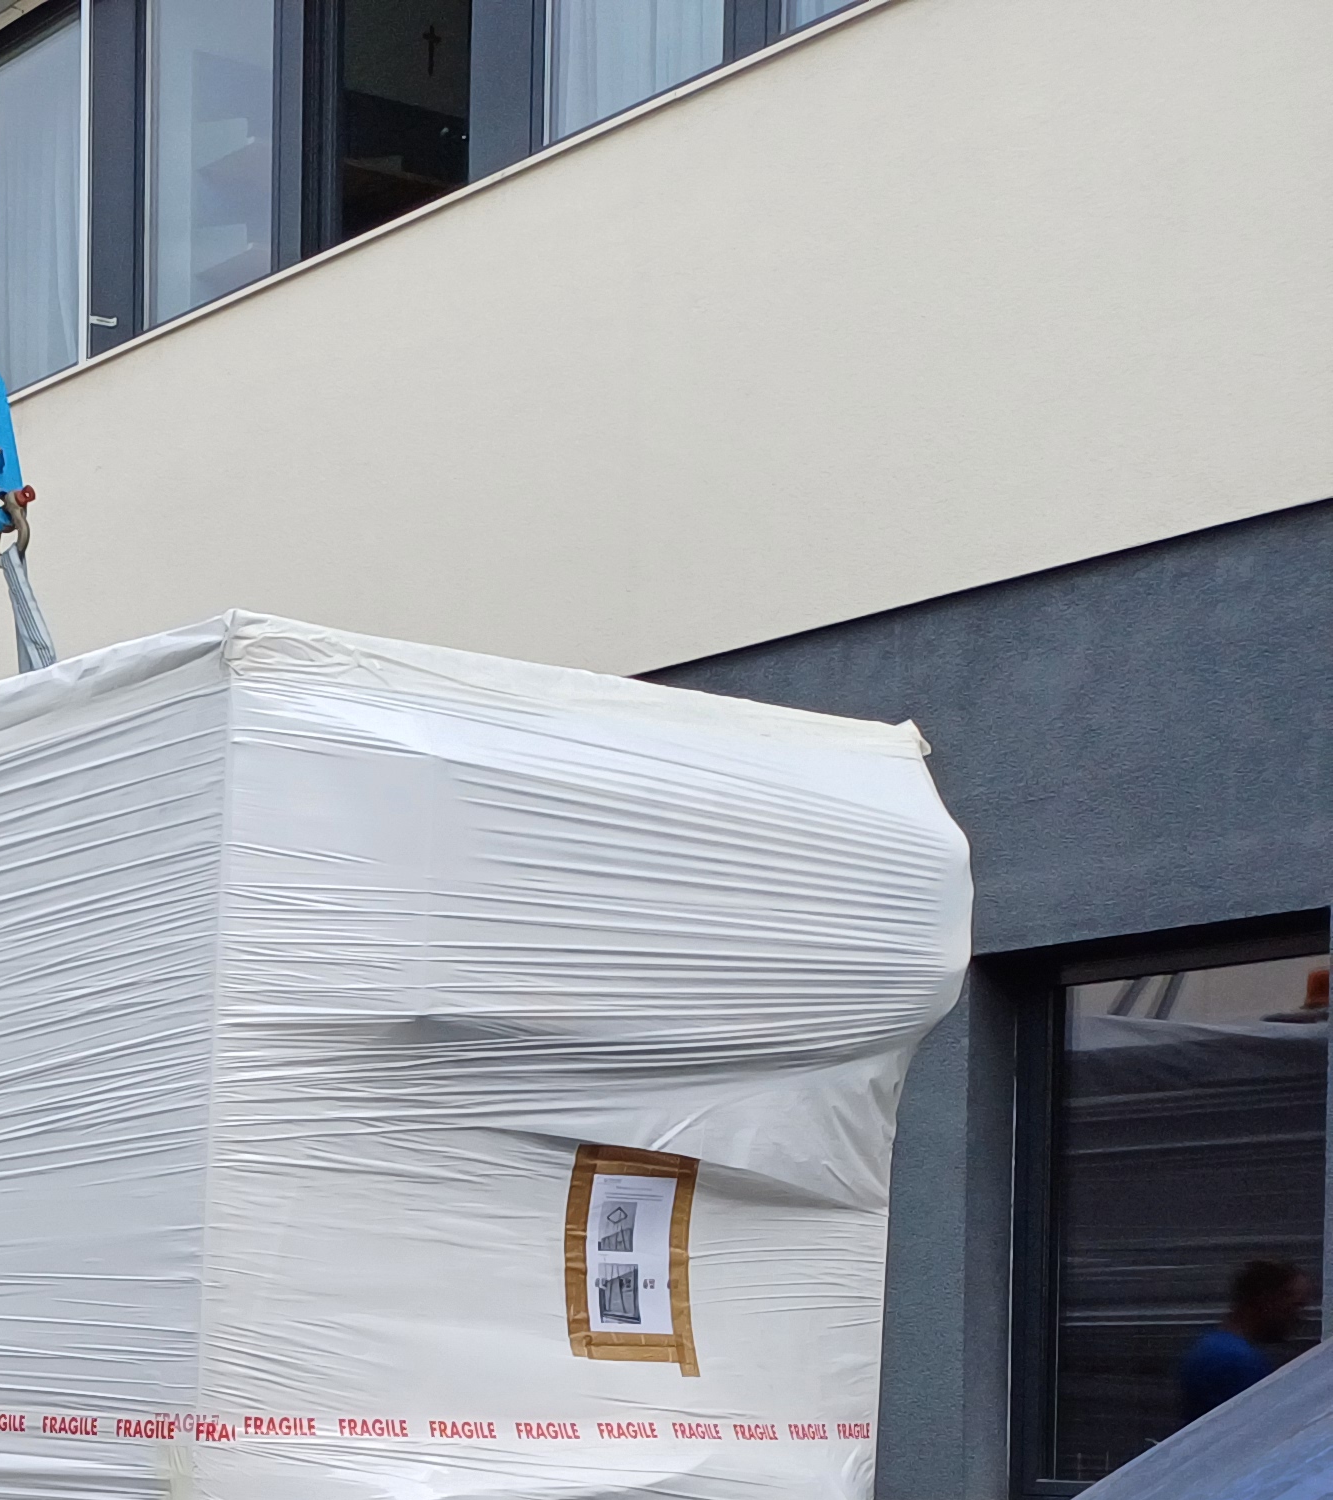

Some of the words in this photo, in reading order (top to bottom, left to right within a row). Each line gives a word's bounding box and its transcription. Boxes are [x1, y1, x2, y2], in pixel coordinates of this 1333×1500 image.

[42, 1416, 98, 1436] FRAGILE
[116, 1418, 175, 1440] FRAGILE
[244, 1416, 316, 1436] FRAGILE
[338, 1418, 408, 1437] FRAGILE
[429, 1420, 497, 1439] FRAGILE
[515, 1422, 581, 1440] FRAGILE
[597, 1422, 658, 1440] FRAGILE
[672, 1422, 722, 1440] FRAGILE
[733, 1423, 778, 1441] FRAGILE
[788, 1423, 828, 1441] FRAGILE
[837, 1422, 870, 1439] FRAGILE
